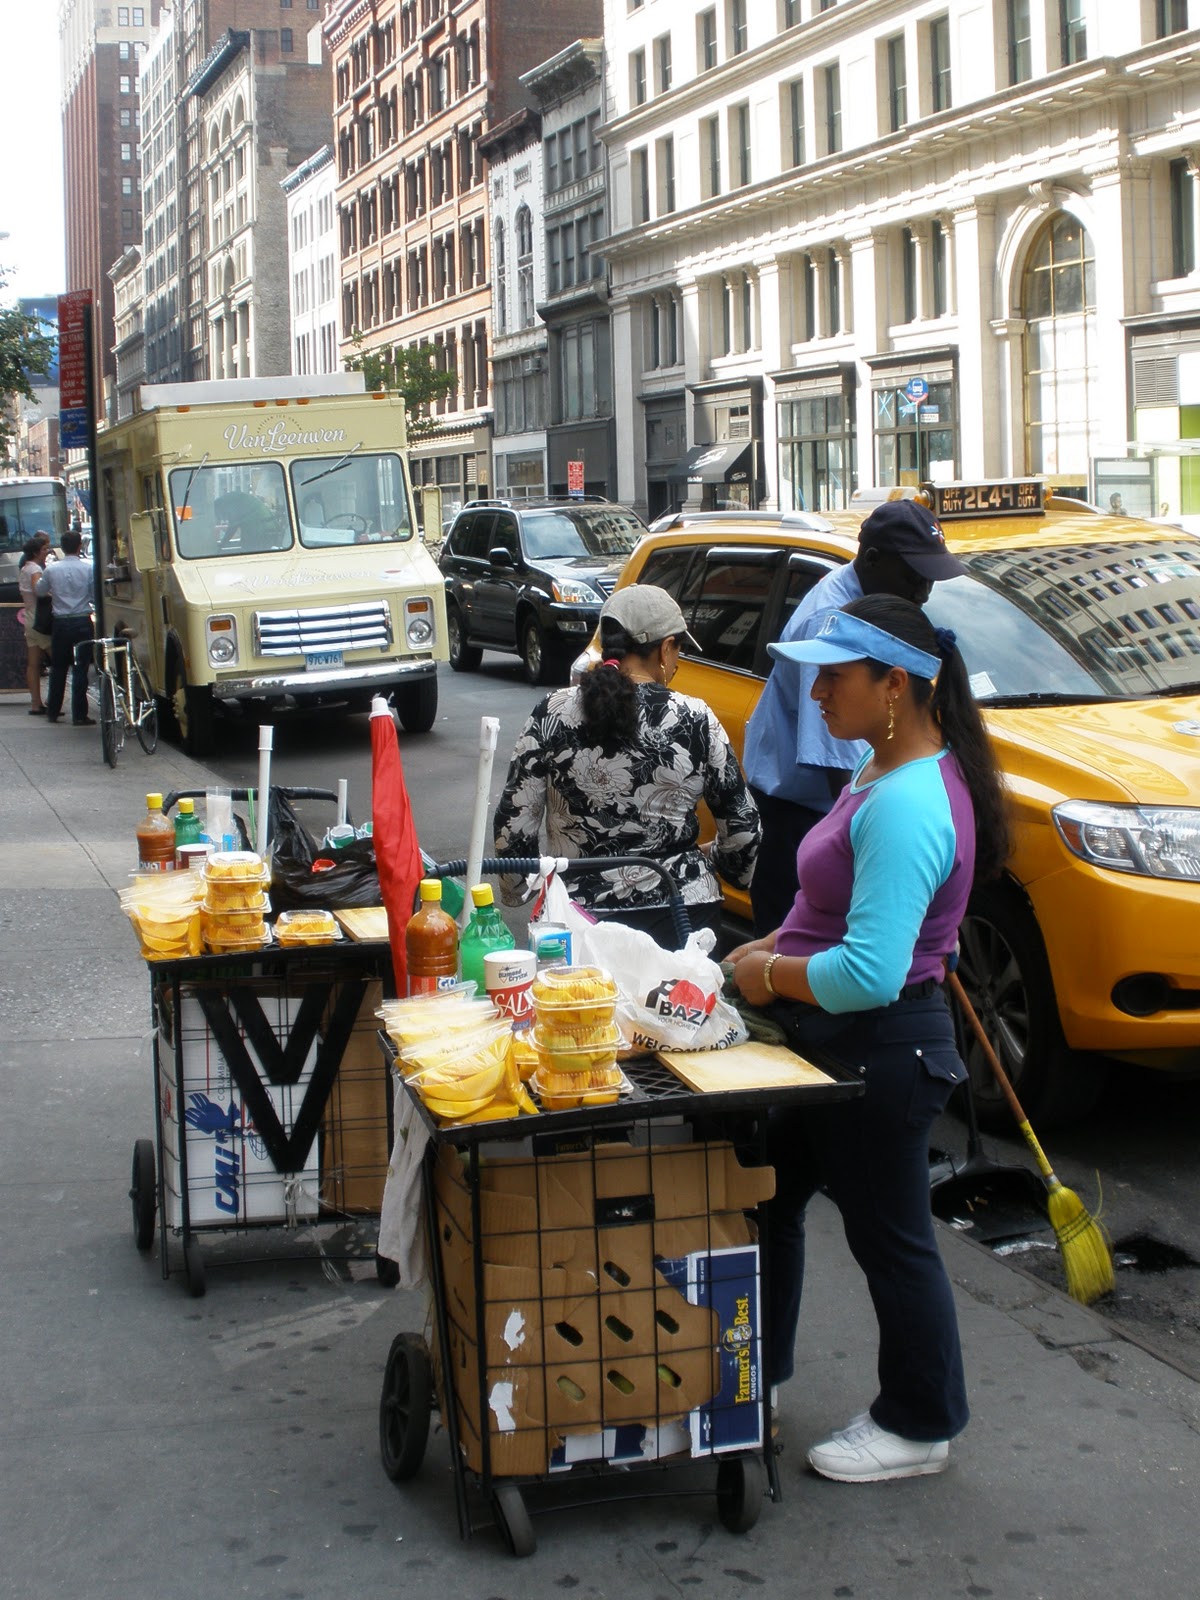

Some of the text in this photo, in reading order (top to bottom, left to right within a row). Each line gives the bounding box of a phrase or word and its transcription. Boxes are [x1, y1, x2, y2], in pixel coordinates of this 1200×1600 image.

[944, 488, 961, 499] OFF
[1018, 483, 1036, 495] OFF
[943, 499, 963, 512] DUTY
[1017, 495, 1037, 508] DUTY
[632, 1026, 739, 1054] WELCOME HOME
[217, 1056, 226, 1102] COLUMBIA
[734, 1297, 750, 1404] Farmer's Best
